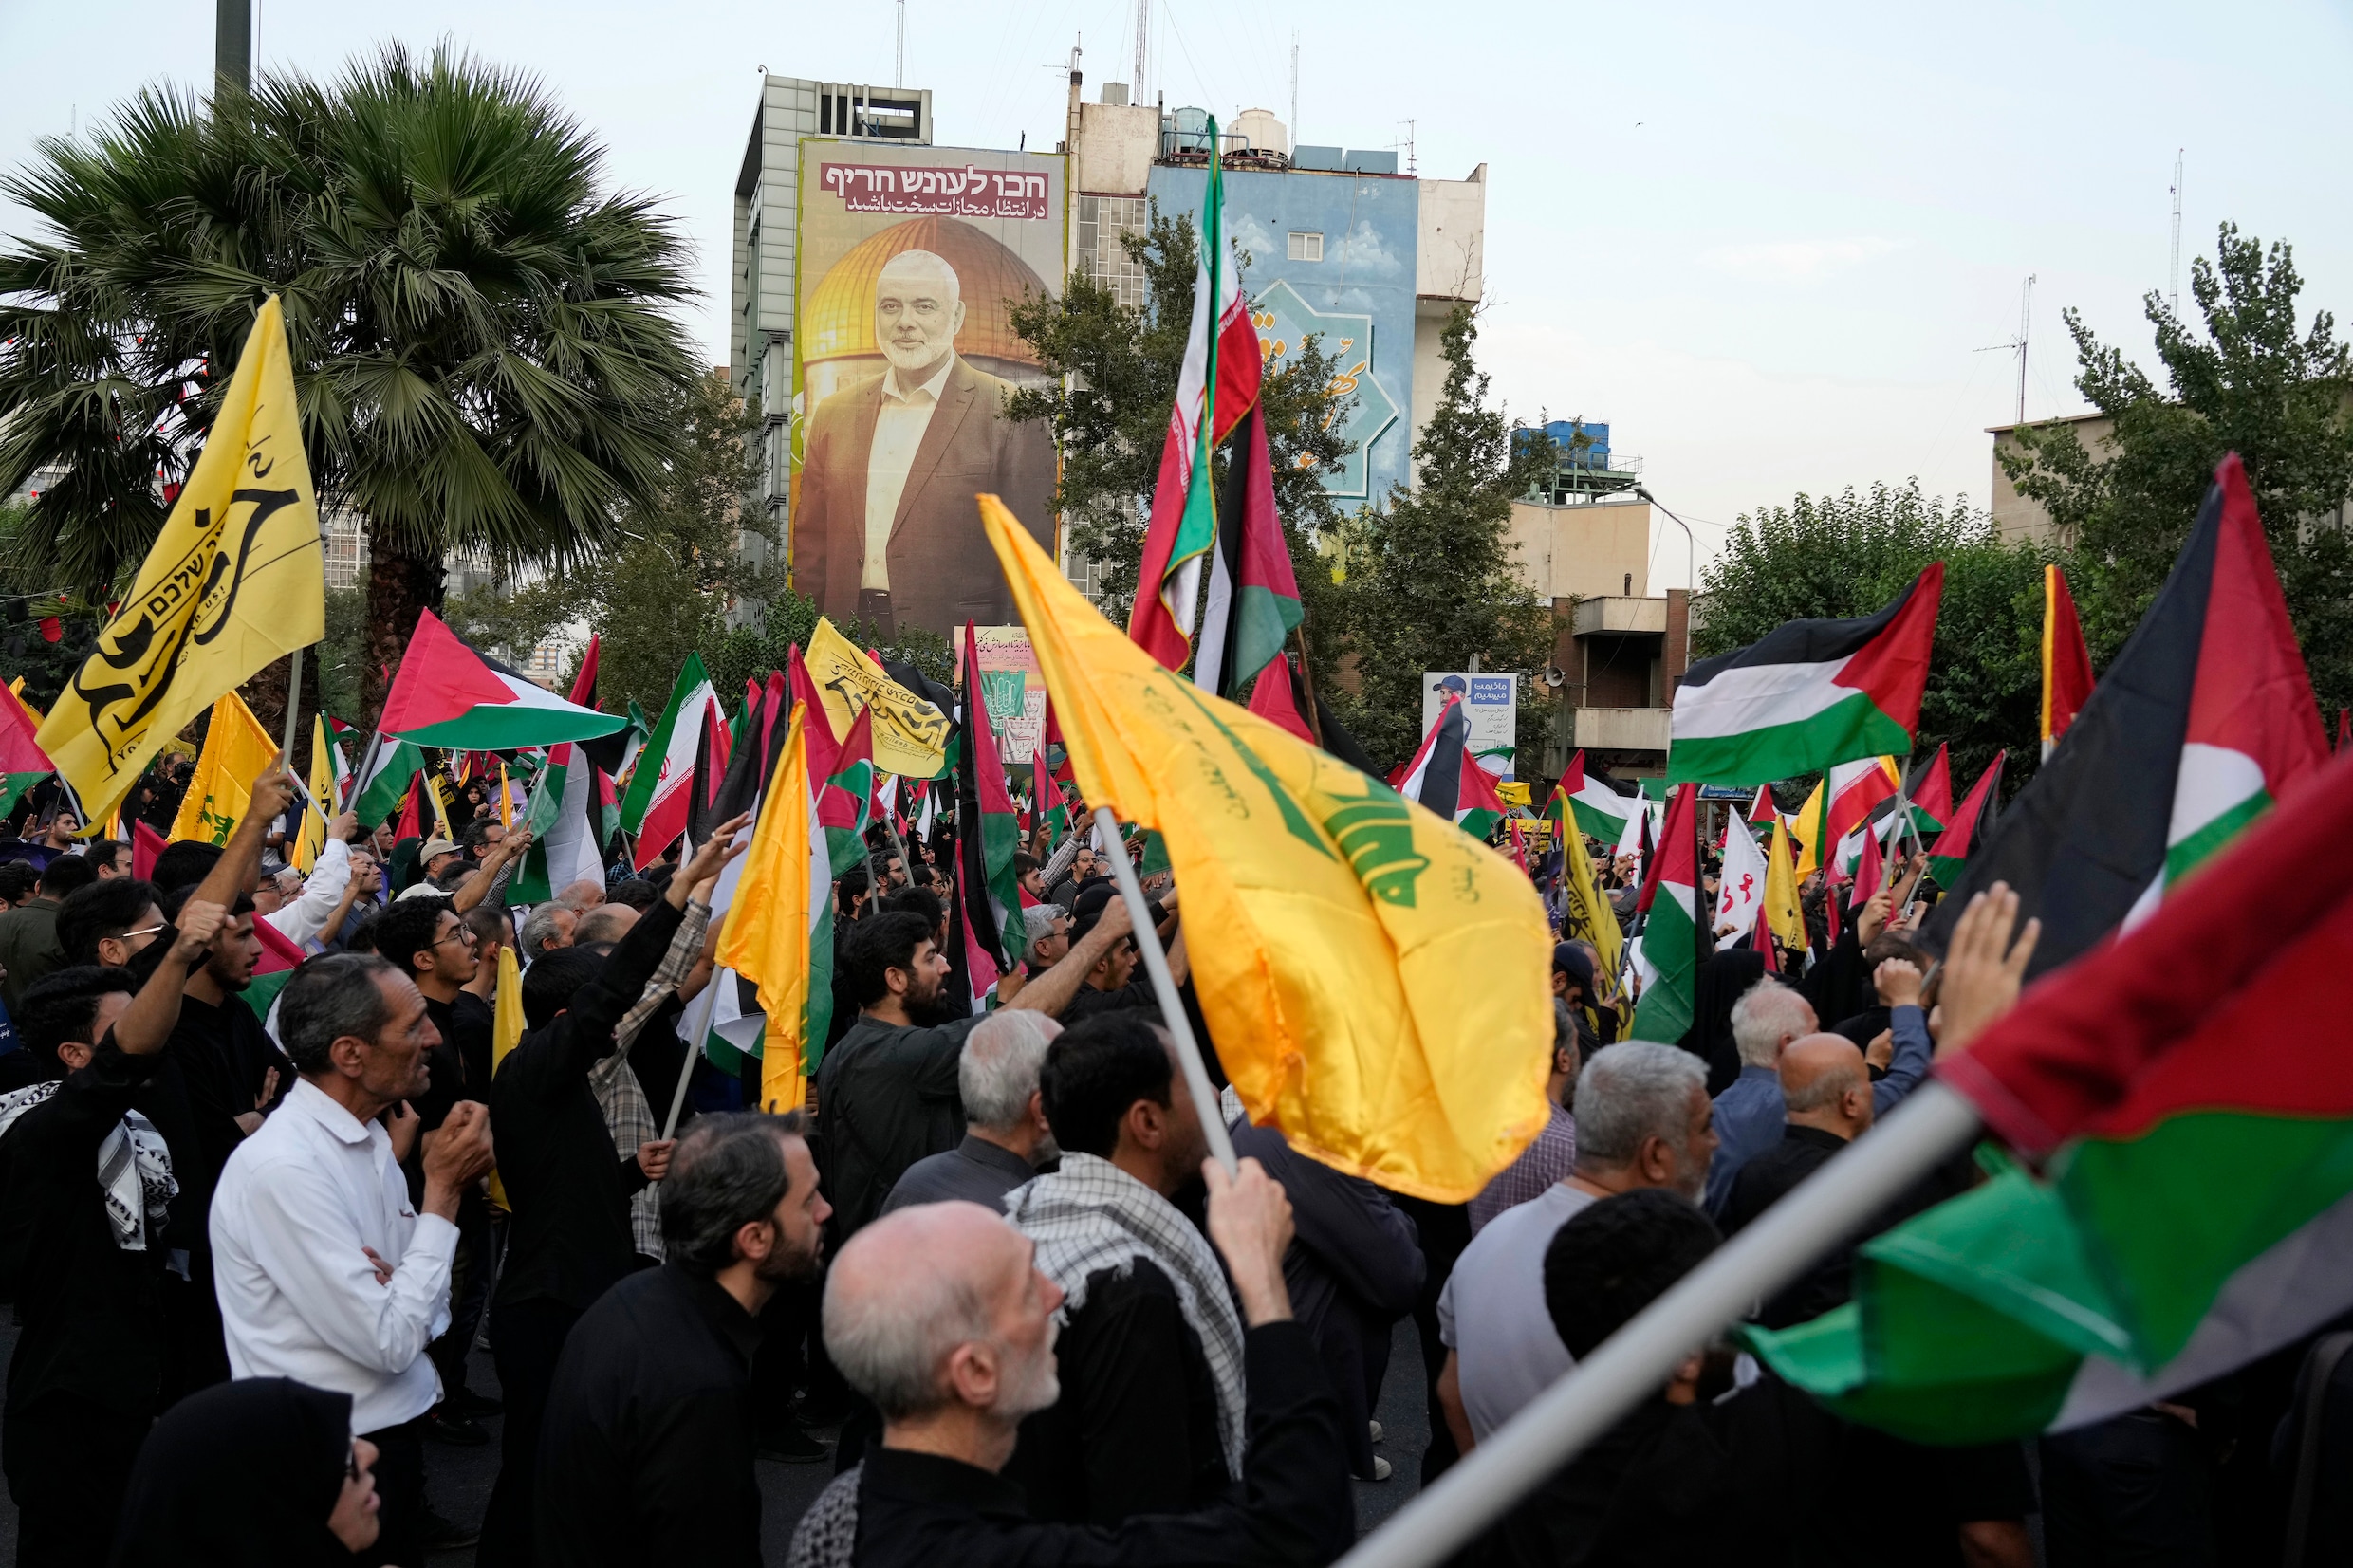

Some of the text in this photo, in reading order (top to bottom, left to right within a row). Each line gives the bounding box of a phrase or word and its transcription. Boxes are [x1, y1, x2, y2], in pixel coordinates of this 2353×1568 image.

[825, 164, 1045, 198] חכו לעונש חריף
[846, 194, 1046, 222] در انتظار مجازات سخت باشید
[146, 553, 206, 618] שלכם
